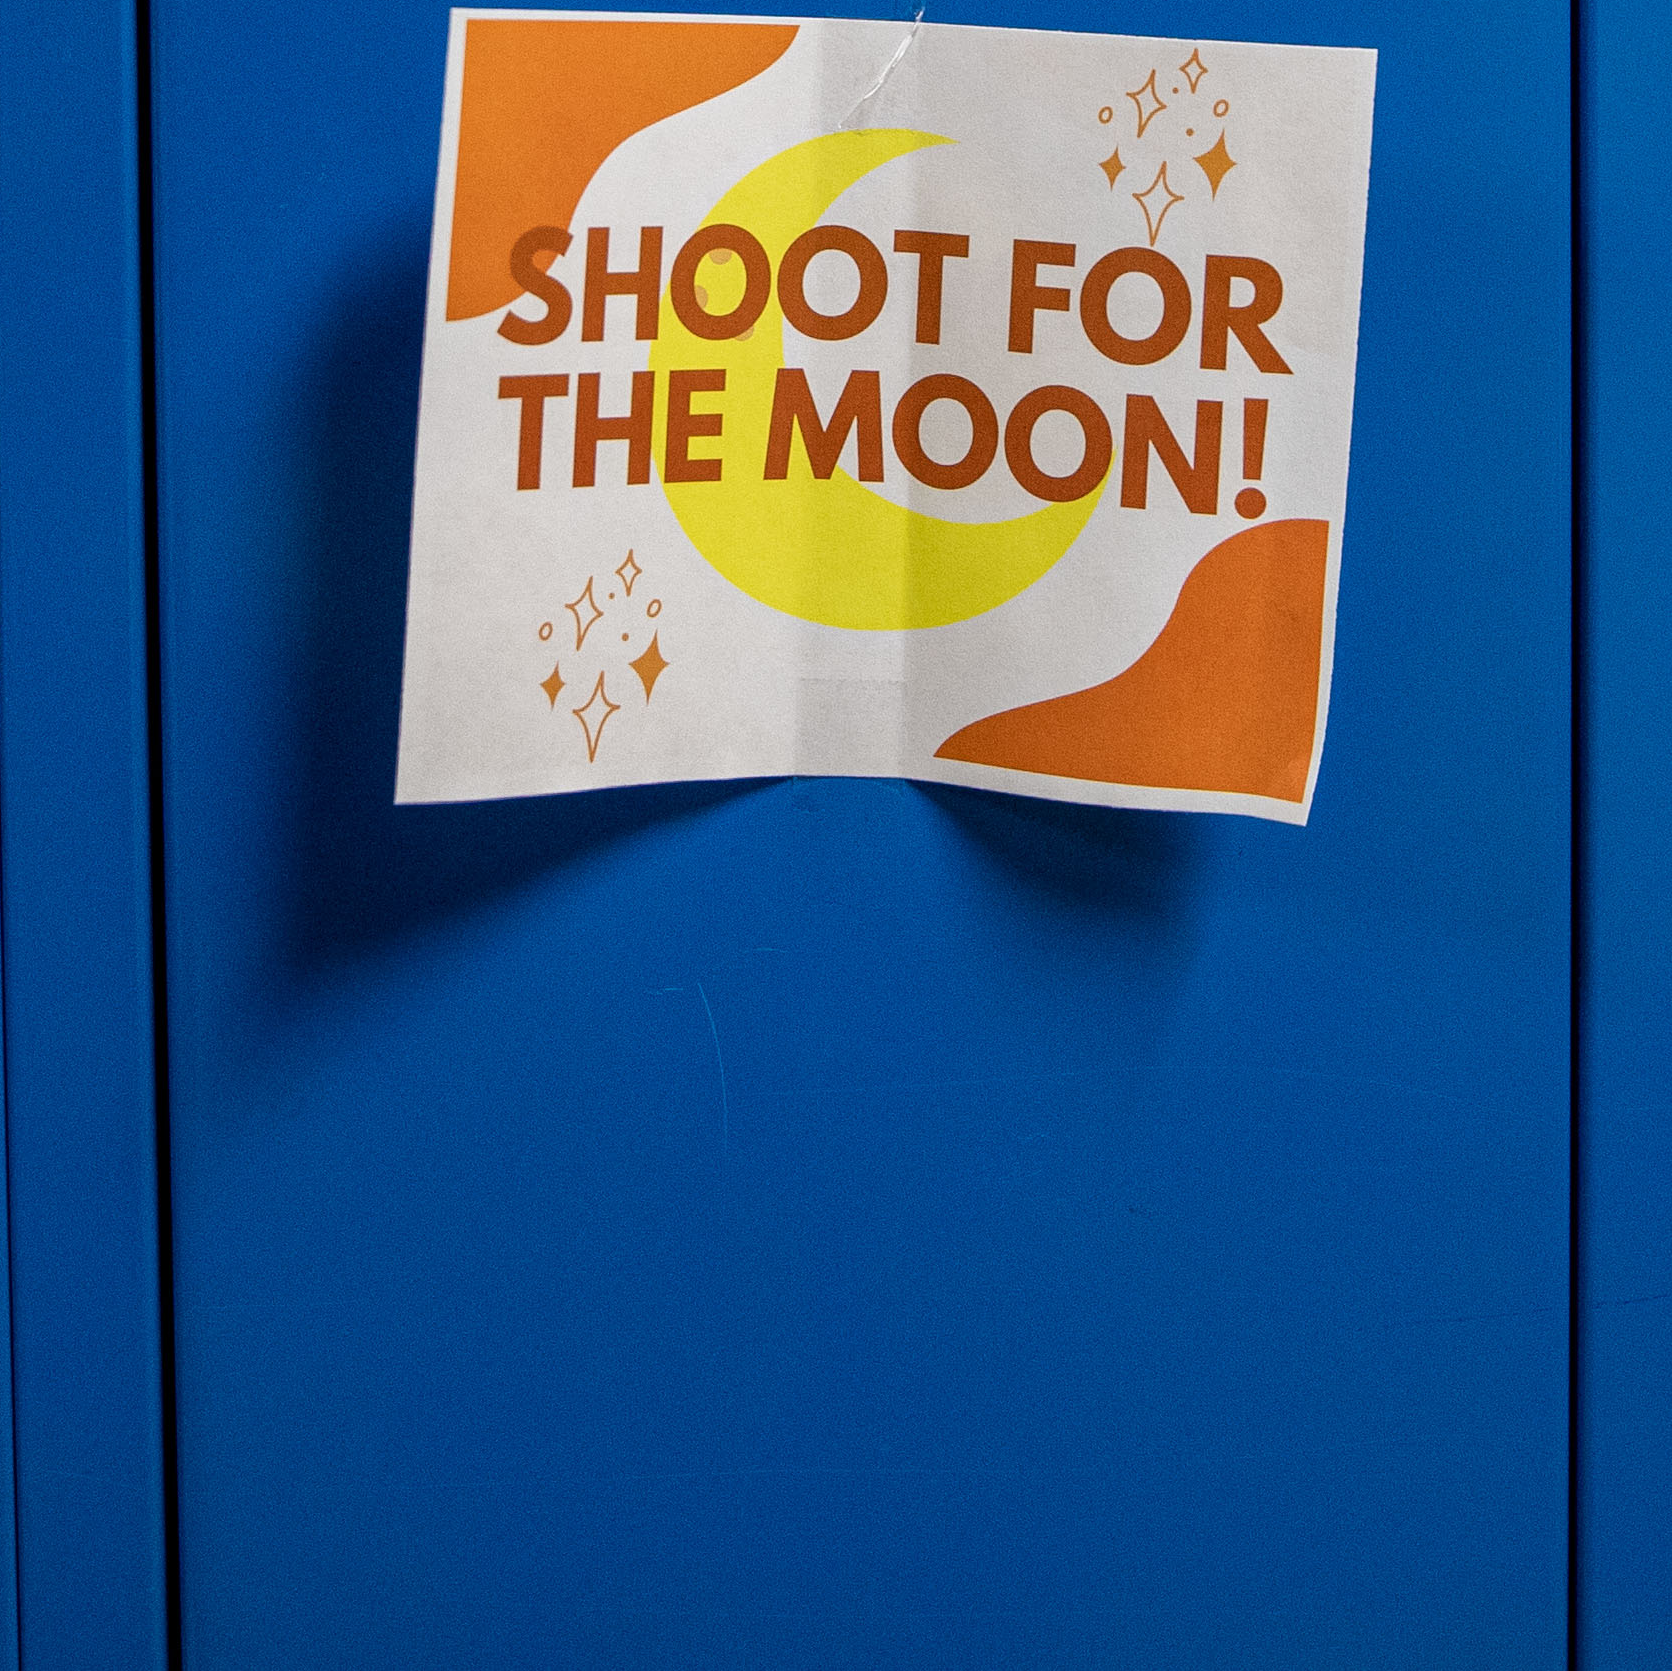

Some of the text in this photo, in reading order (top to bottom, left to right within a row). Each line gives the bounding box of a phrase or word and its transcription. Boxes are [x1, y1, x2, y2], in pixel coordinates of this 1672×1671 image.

[496, 222, 1295, 376] SHOOT FOR
[496, 367, 1270, 521] THE MOON!
